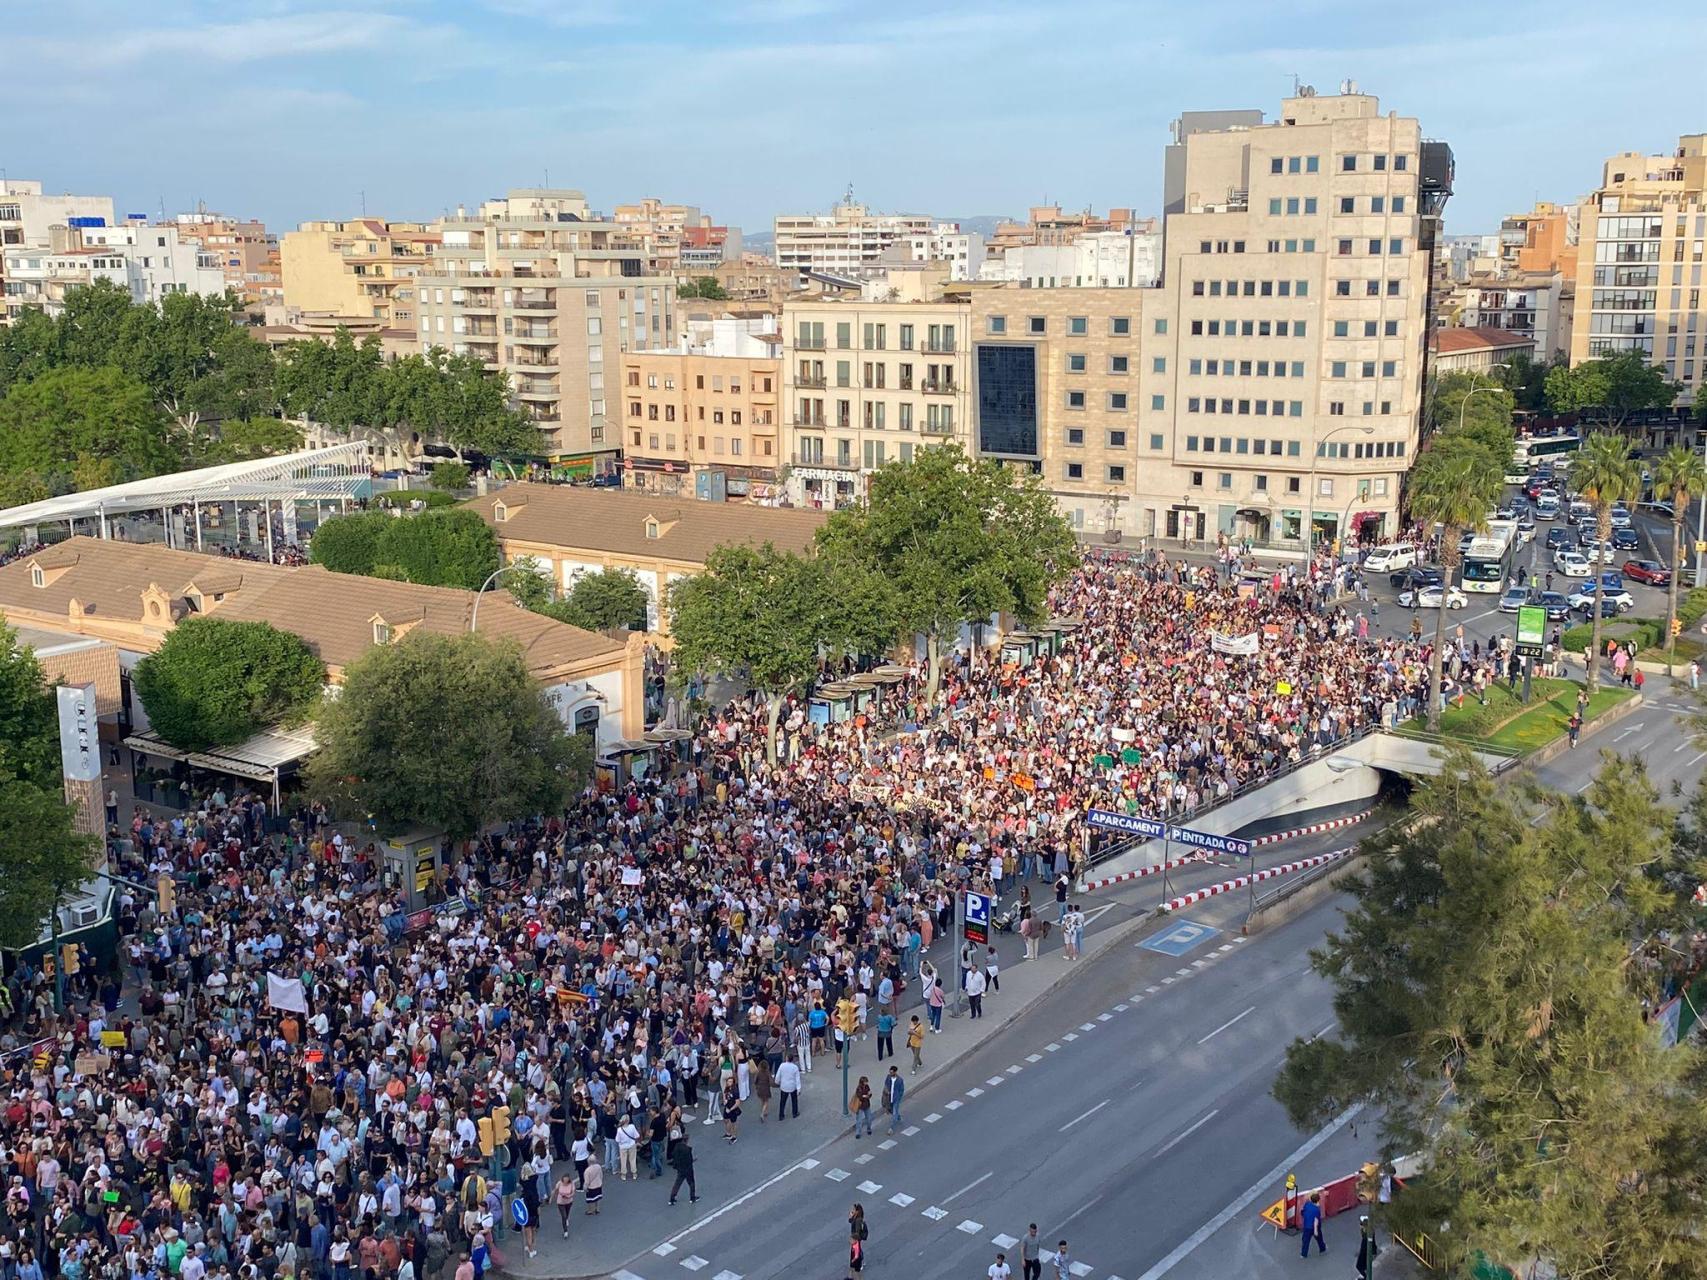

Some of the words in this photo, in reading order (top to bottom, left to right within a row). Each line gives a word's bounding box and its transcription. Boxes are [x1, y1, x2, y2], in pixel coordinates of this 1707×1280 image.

[1091, 812, 1161, 835] APARCAMENT
[1172, 829, 1181, 840] P
[1182, 832, 1225, 850] ENTRADA
[966, 894, 982, 917] P
[1151, 926, 1204, 947] P
